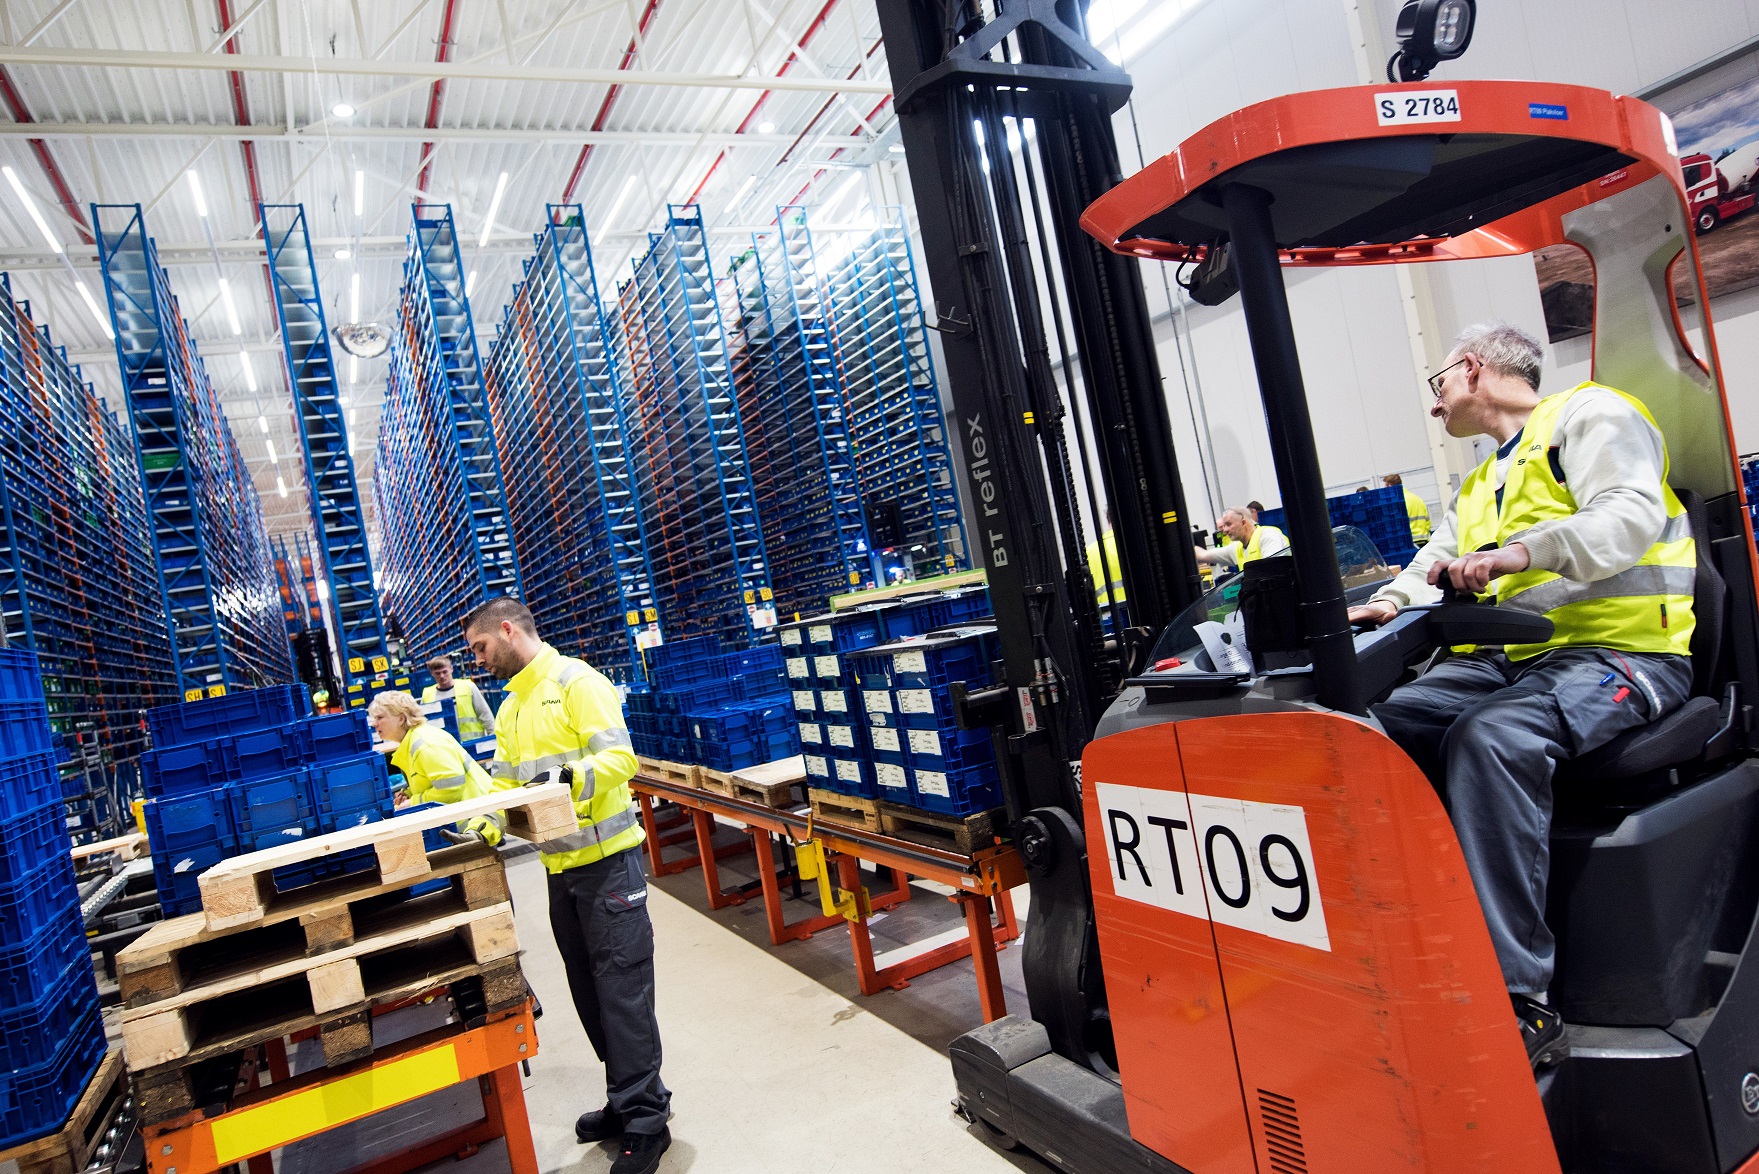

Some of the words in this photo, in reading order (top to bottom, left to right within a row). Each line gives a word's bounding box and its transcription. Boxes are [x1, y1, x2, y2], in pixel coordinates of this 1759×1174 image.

[1381, 100, 1396, 118] S
[1405, 97, 1458, 117] 2784
[967, 412, 998, 517] reflex
[988, 529, 1009, 568] BT
[627, 614, 639, 624] SL
[645, 610, 657, 621] SM
[350, 659, 362, 671] SJ
[374, 658, 387, 671] SK
[1107, 808, 1311, 922] RT09
